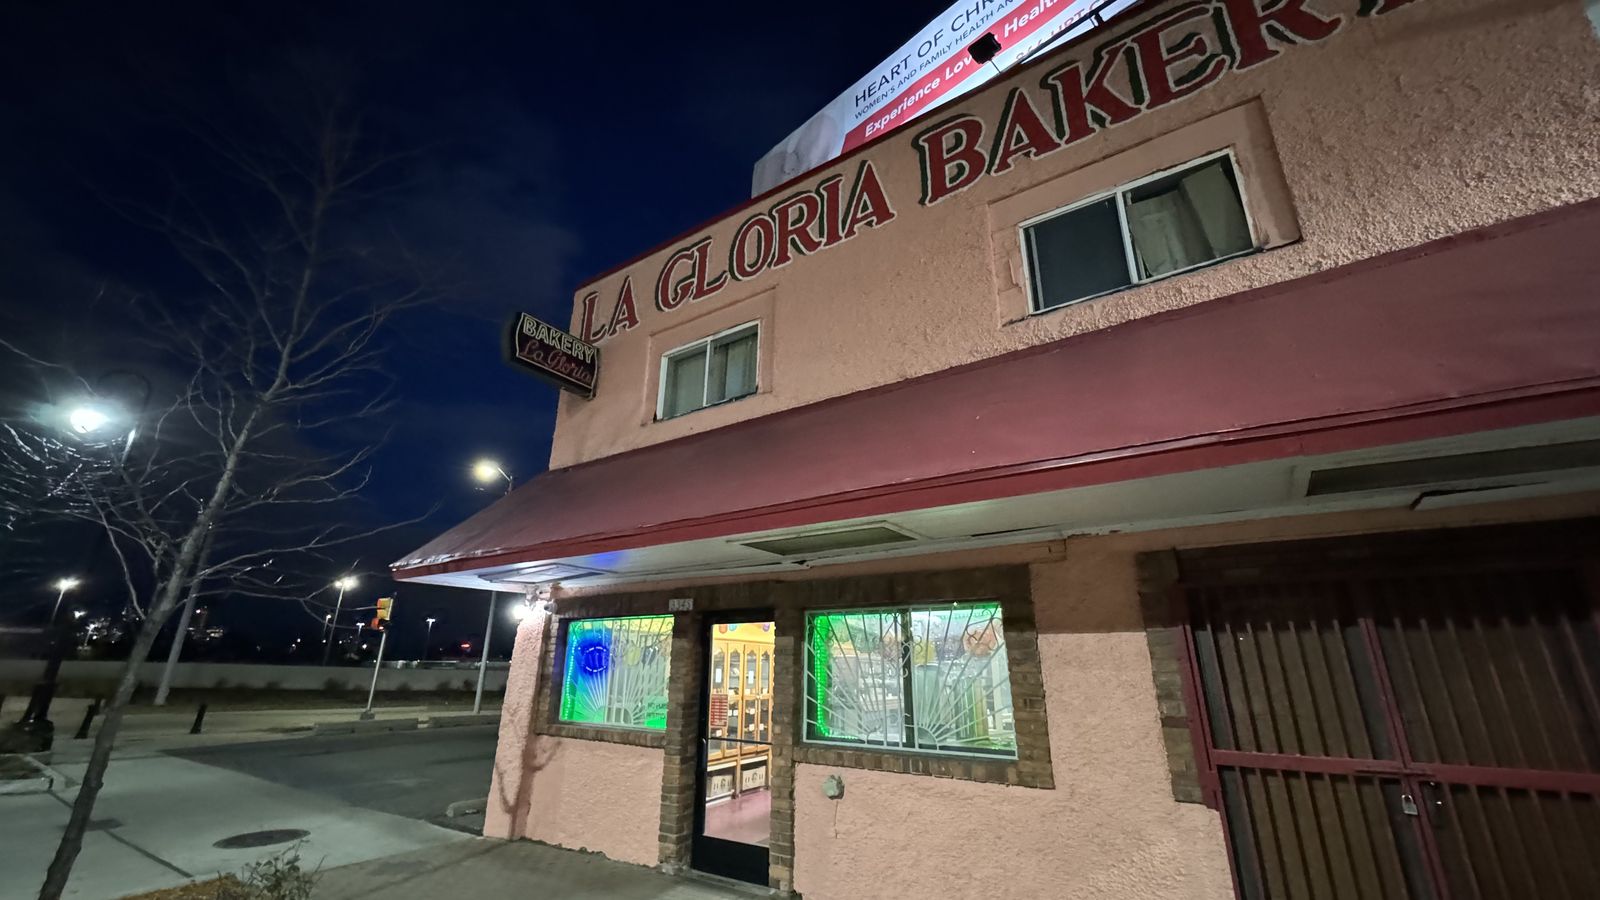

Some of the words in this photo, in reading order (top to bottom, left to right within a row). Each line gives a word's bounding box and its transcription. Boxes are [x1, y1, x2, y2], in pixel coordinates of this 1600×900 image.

[854, 87, 895, 119] WOMEN'S
[897, 68, 917, 89] AND
[919, 44, 953, 71] FAMILY
[955, 10, 994, 45] HEALTH
[854, 54, 912, 108] HEART
[917, 28, 945, 58] OF
[864, 77, 941, 138] Experience
[581, 274, 640, 346] LA
[655, 159, 897, 313] GLORIA
[909, 0, 1411, 207] BAKER
[520, 340, 544, 361] La
[544, 349, 593, 382] Gloria
[522, 315, 595, 364] BAKERY
